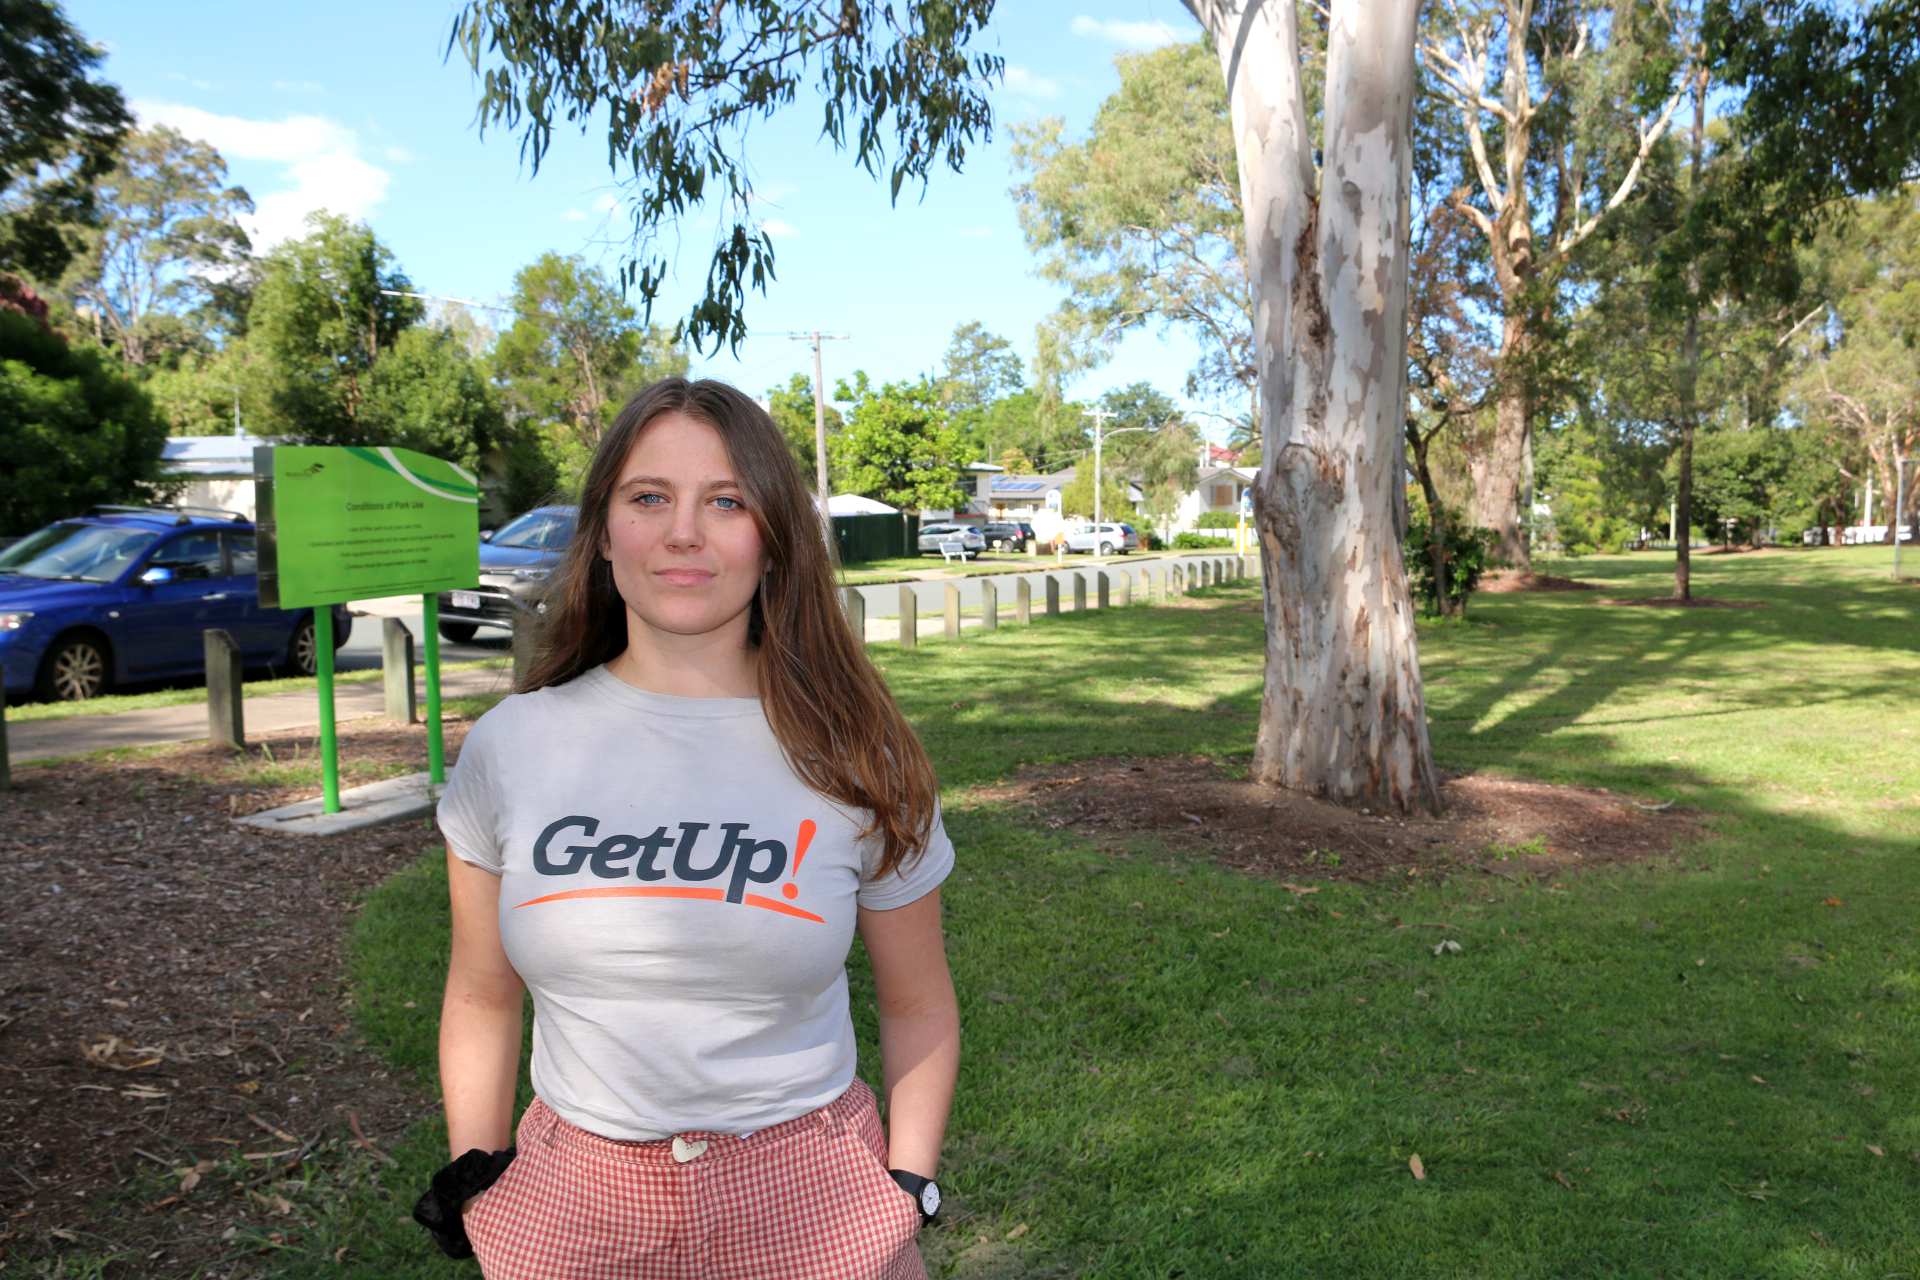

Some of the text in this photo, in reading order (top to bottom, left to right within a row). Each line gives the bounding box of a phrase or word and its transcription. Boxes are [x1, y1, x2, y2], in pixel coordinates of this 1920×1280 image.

[345, 501, 384, 511] Conditions
[385, 501, 394, 510] of
[395, 501, 409, 510] Park
[533, 815, 817, 904] GetUp!
